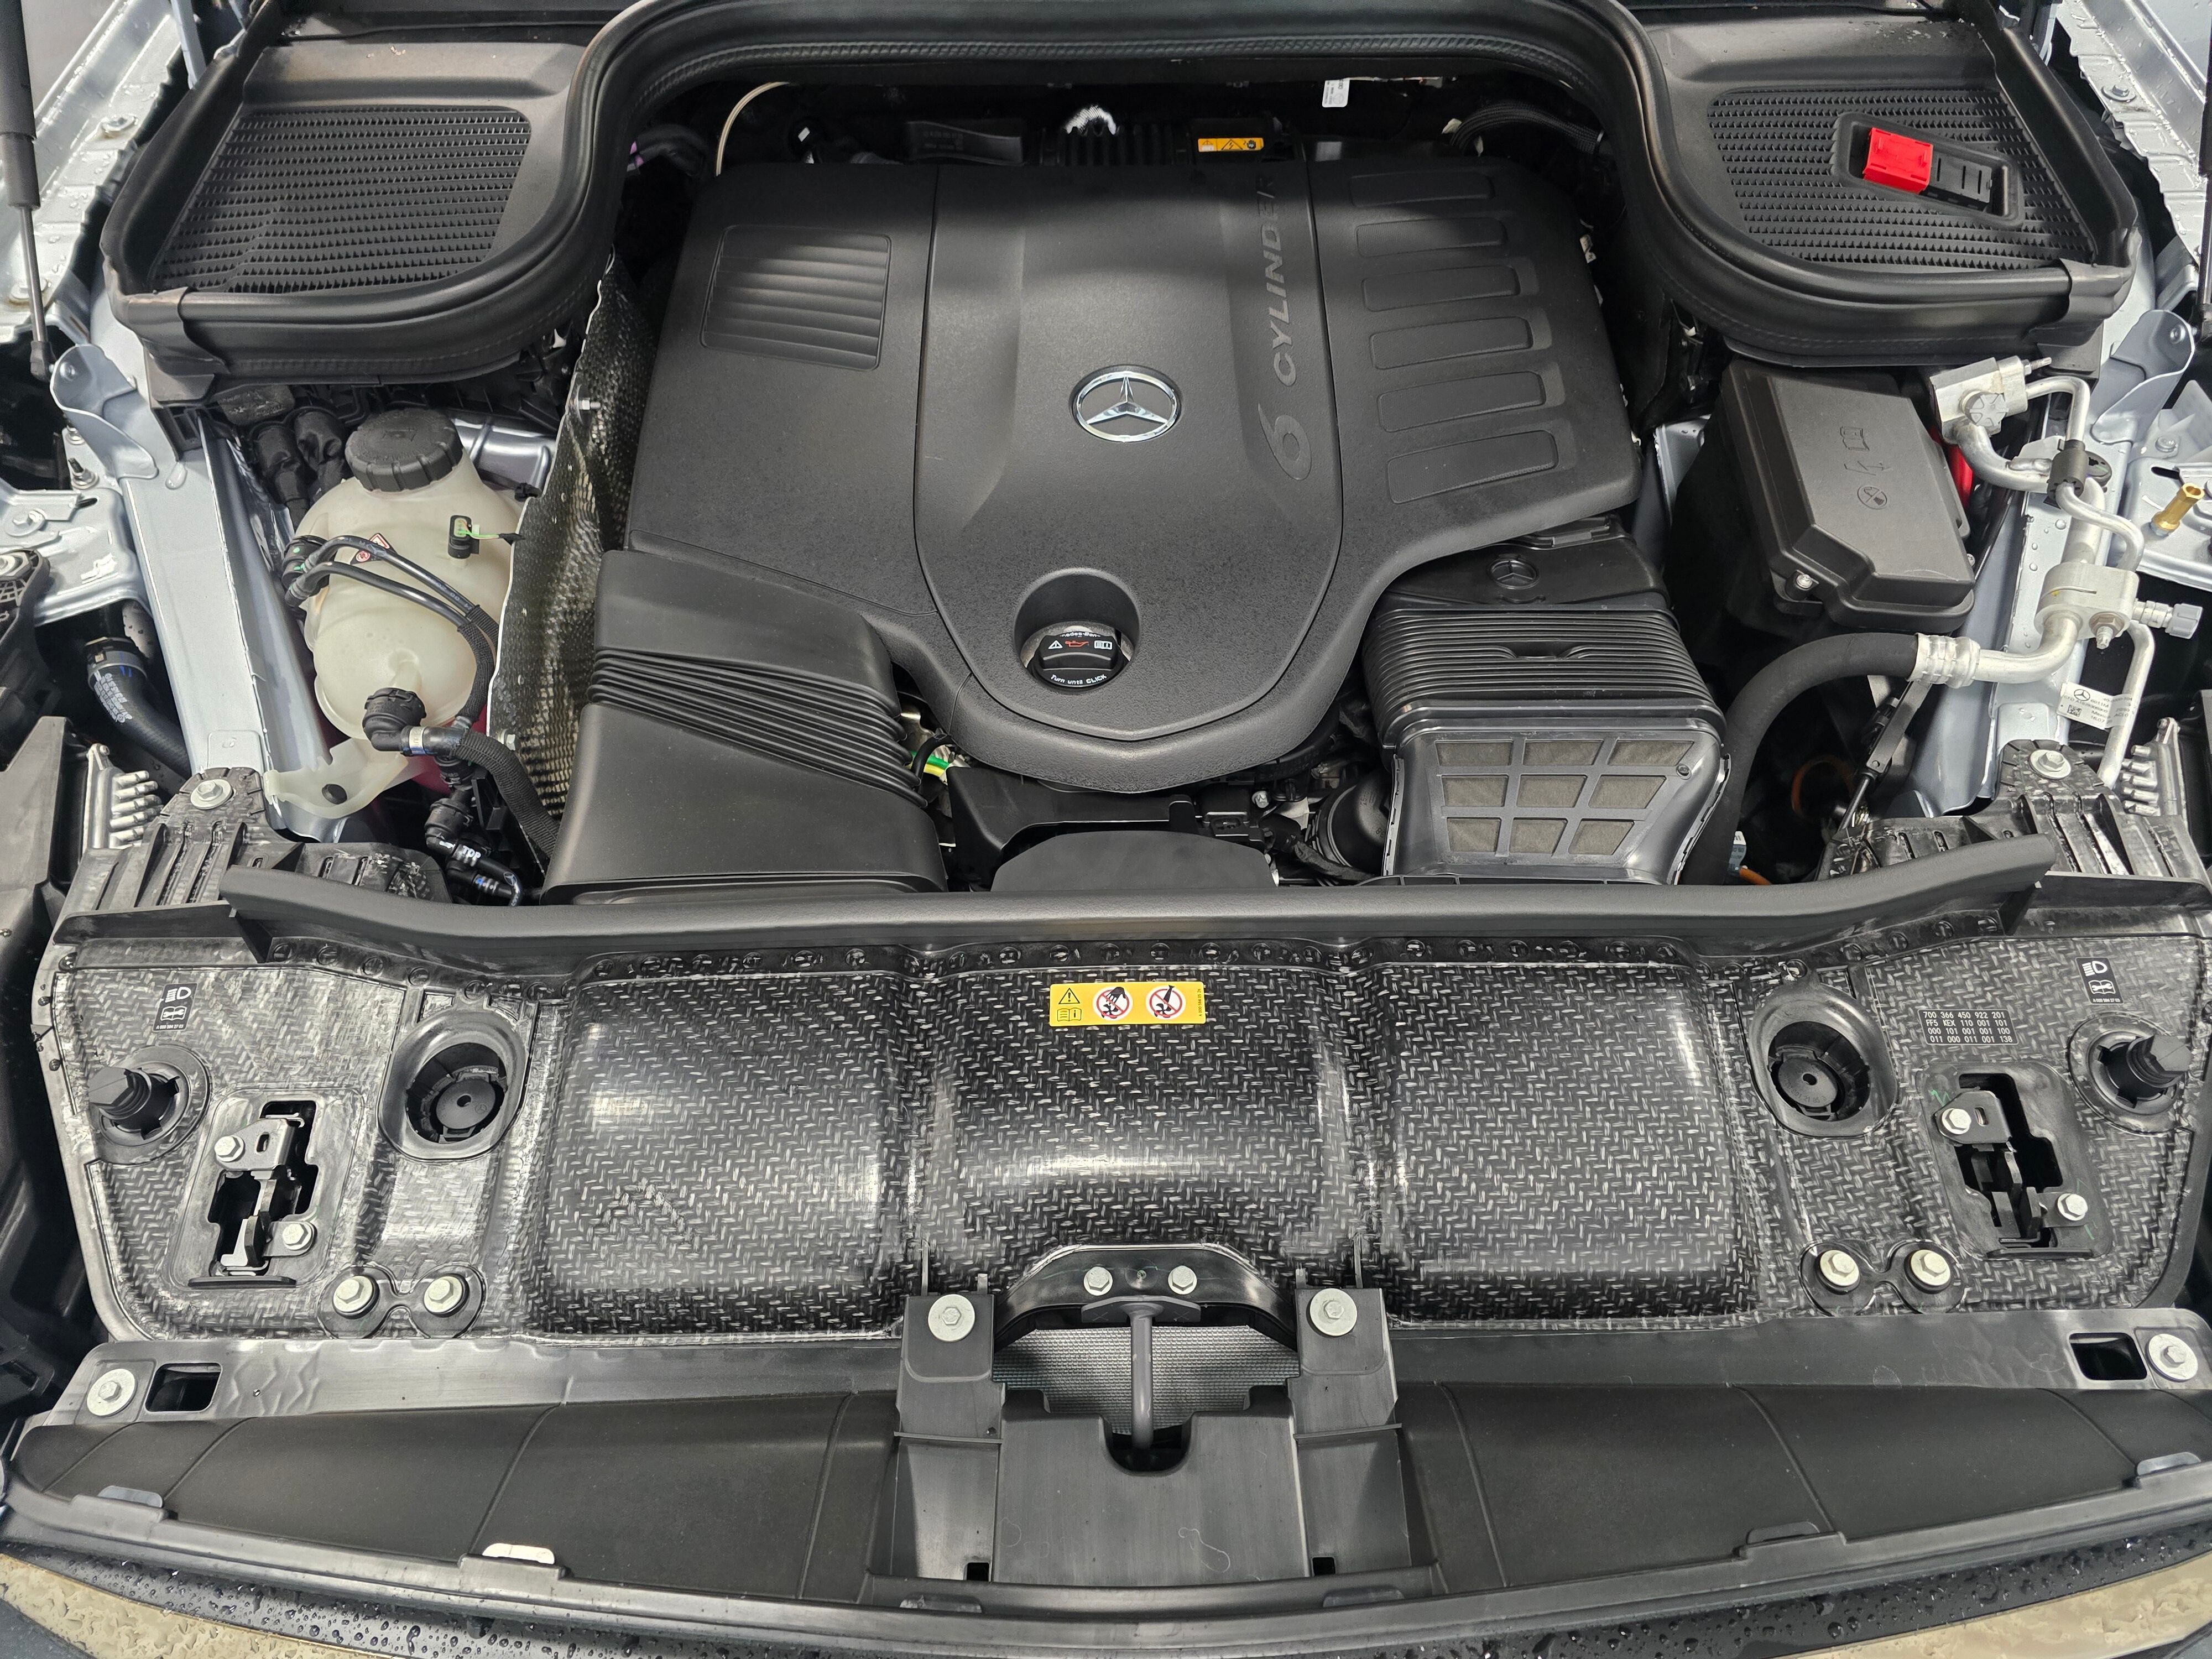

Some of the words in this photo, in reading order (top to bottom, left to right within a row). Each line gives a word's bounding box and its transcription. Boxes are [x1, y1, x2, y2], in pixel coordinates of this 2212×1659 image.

[1256, 176, 1297, 387] CYLINDER
[1258, 403, 1312, 481] 6
[1051, 674, 1066, 684] Turn
[1086, 674, 1107, 684] CLICK
[463, 845, 482, 859] TOP
